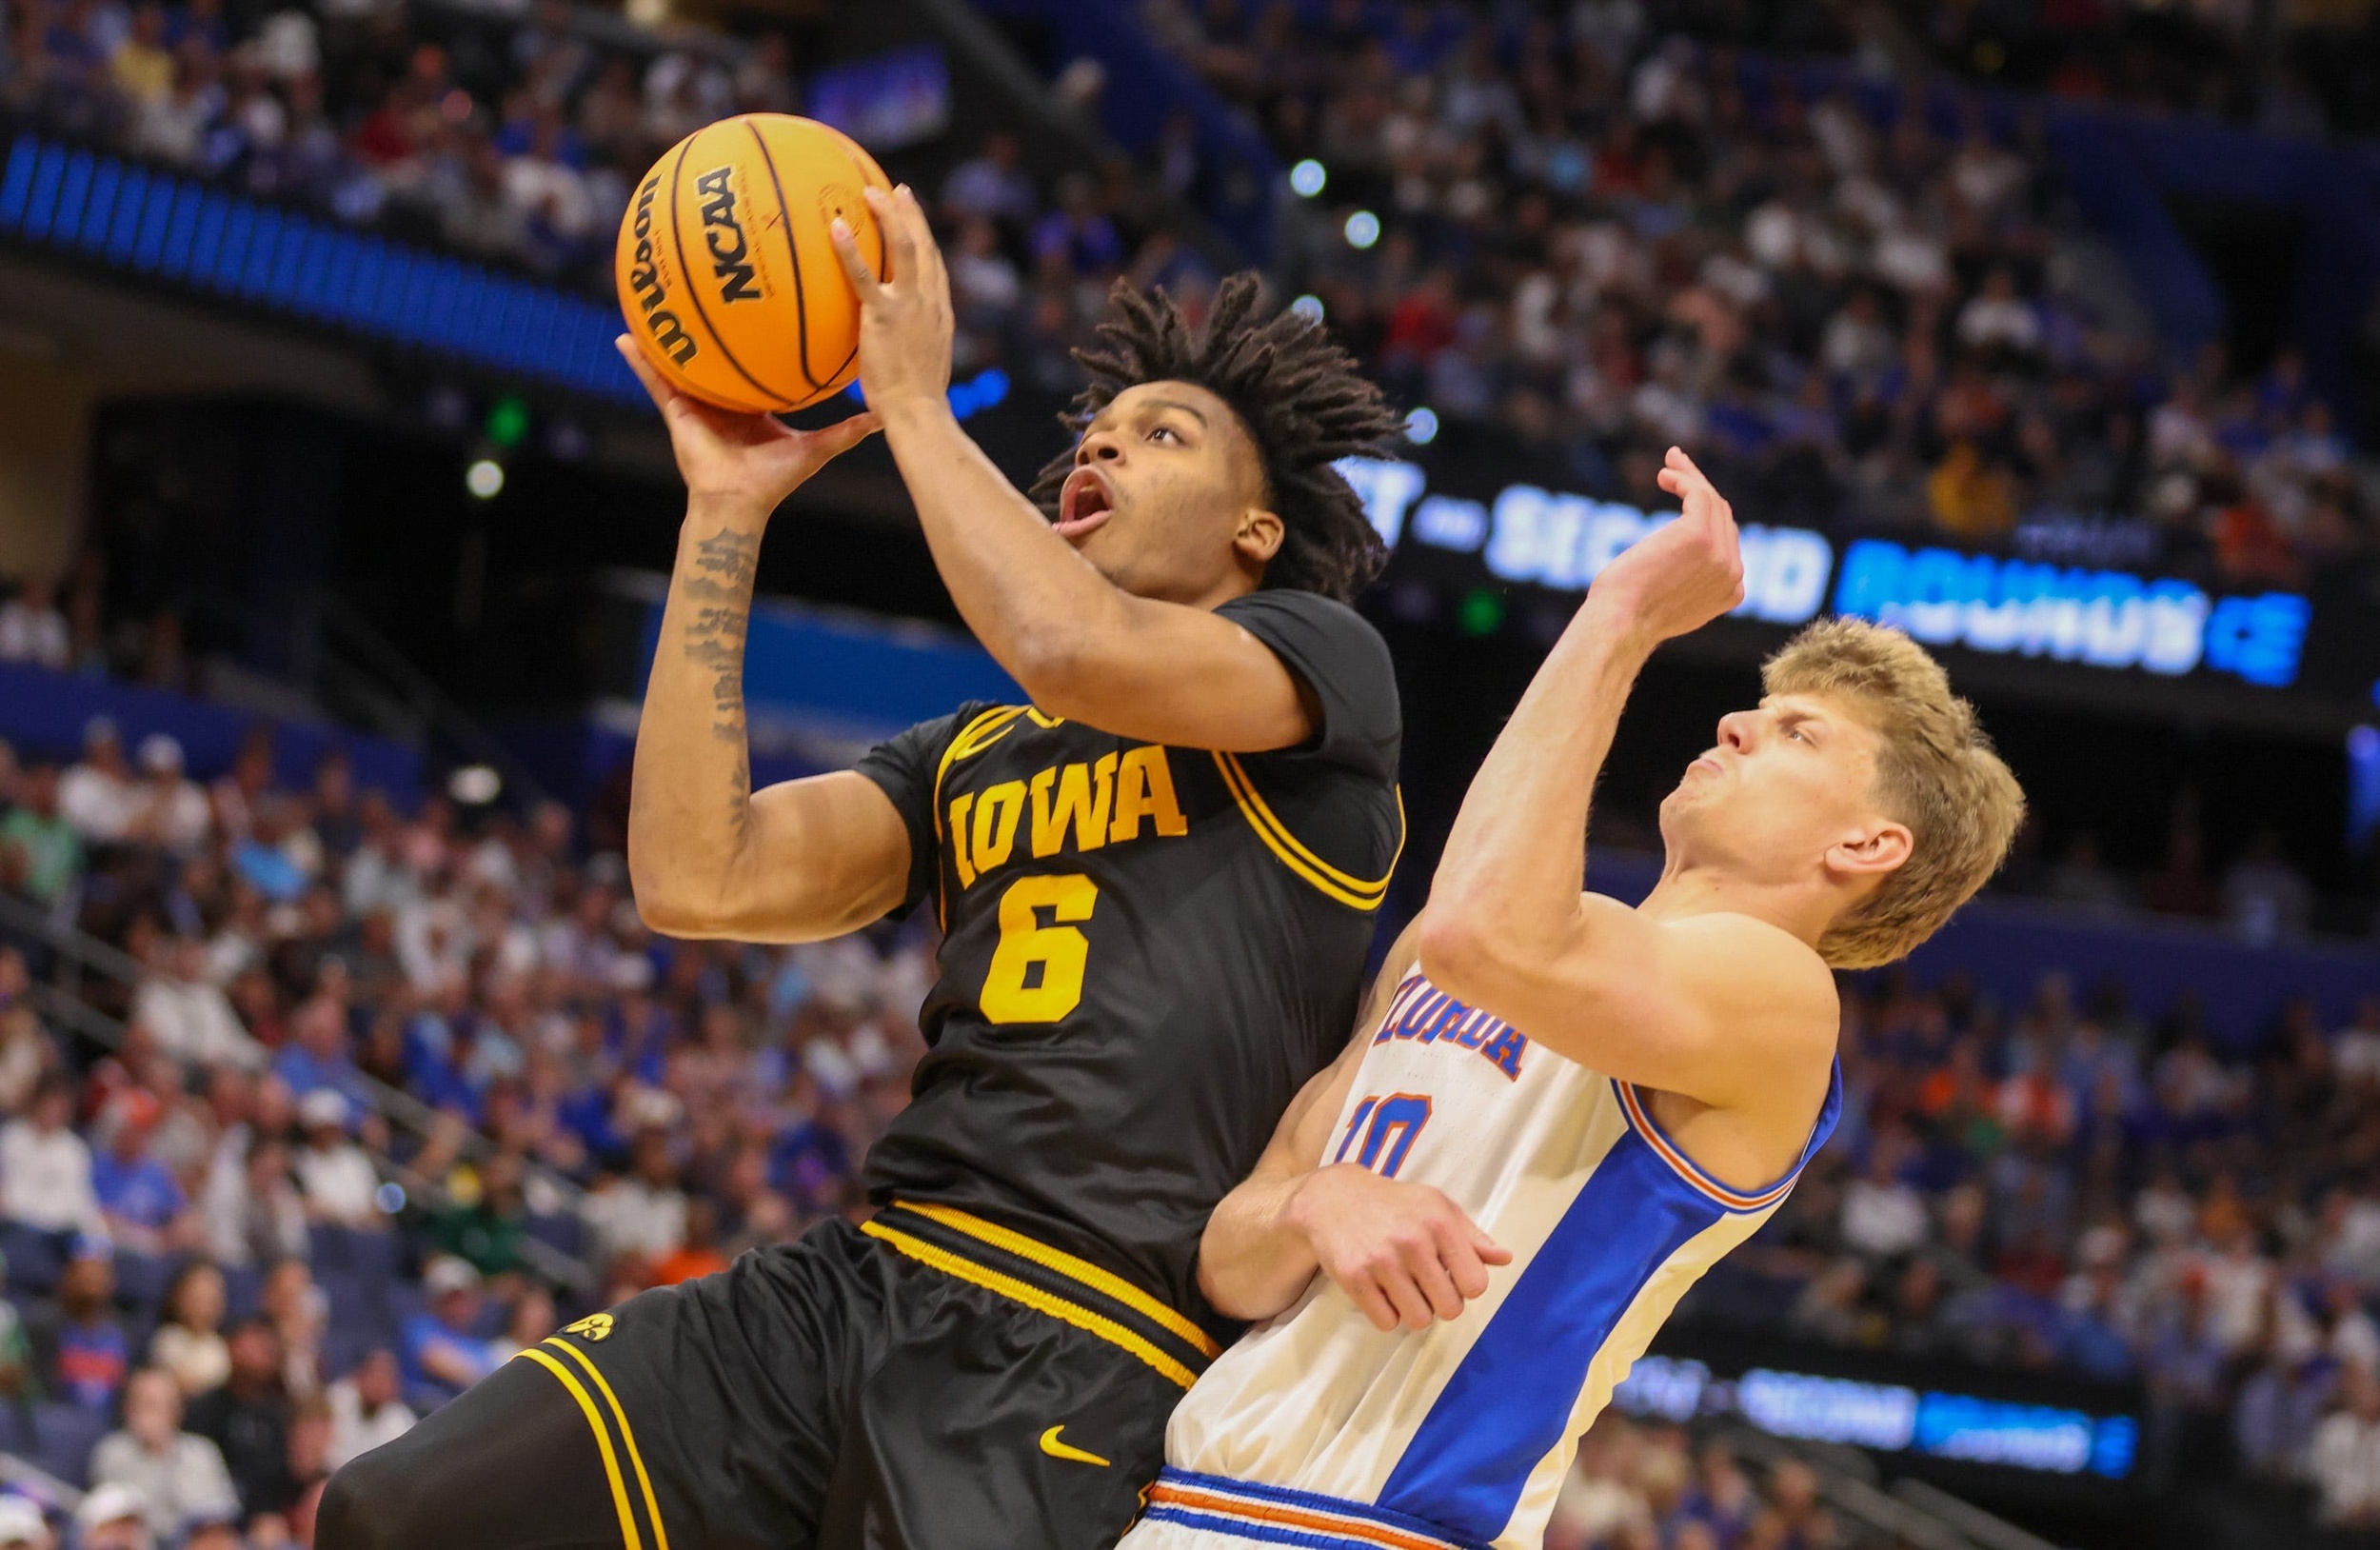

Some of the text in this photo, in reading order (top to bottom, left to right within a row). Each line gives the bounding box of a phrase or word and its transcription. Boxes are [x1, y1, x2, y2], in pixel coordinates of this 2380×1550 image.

[629, 171, 699, 372] Wilson
[694, 164, 762, 305] NCAA
[948, 745, 1188, 891] IOWA
[979, 873, 1099, 1025] 6
[1373, 973, 1529, 1083] LORIDA
[1334, 1091, 1433, 1180] 10
